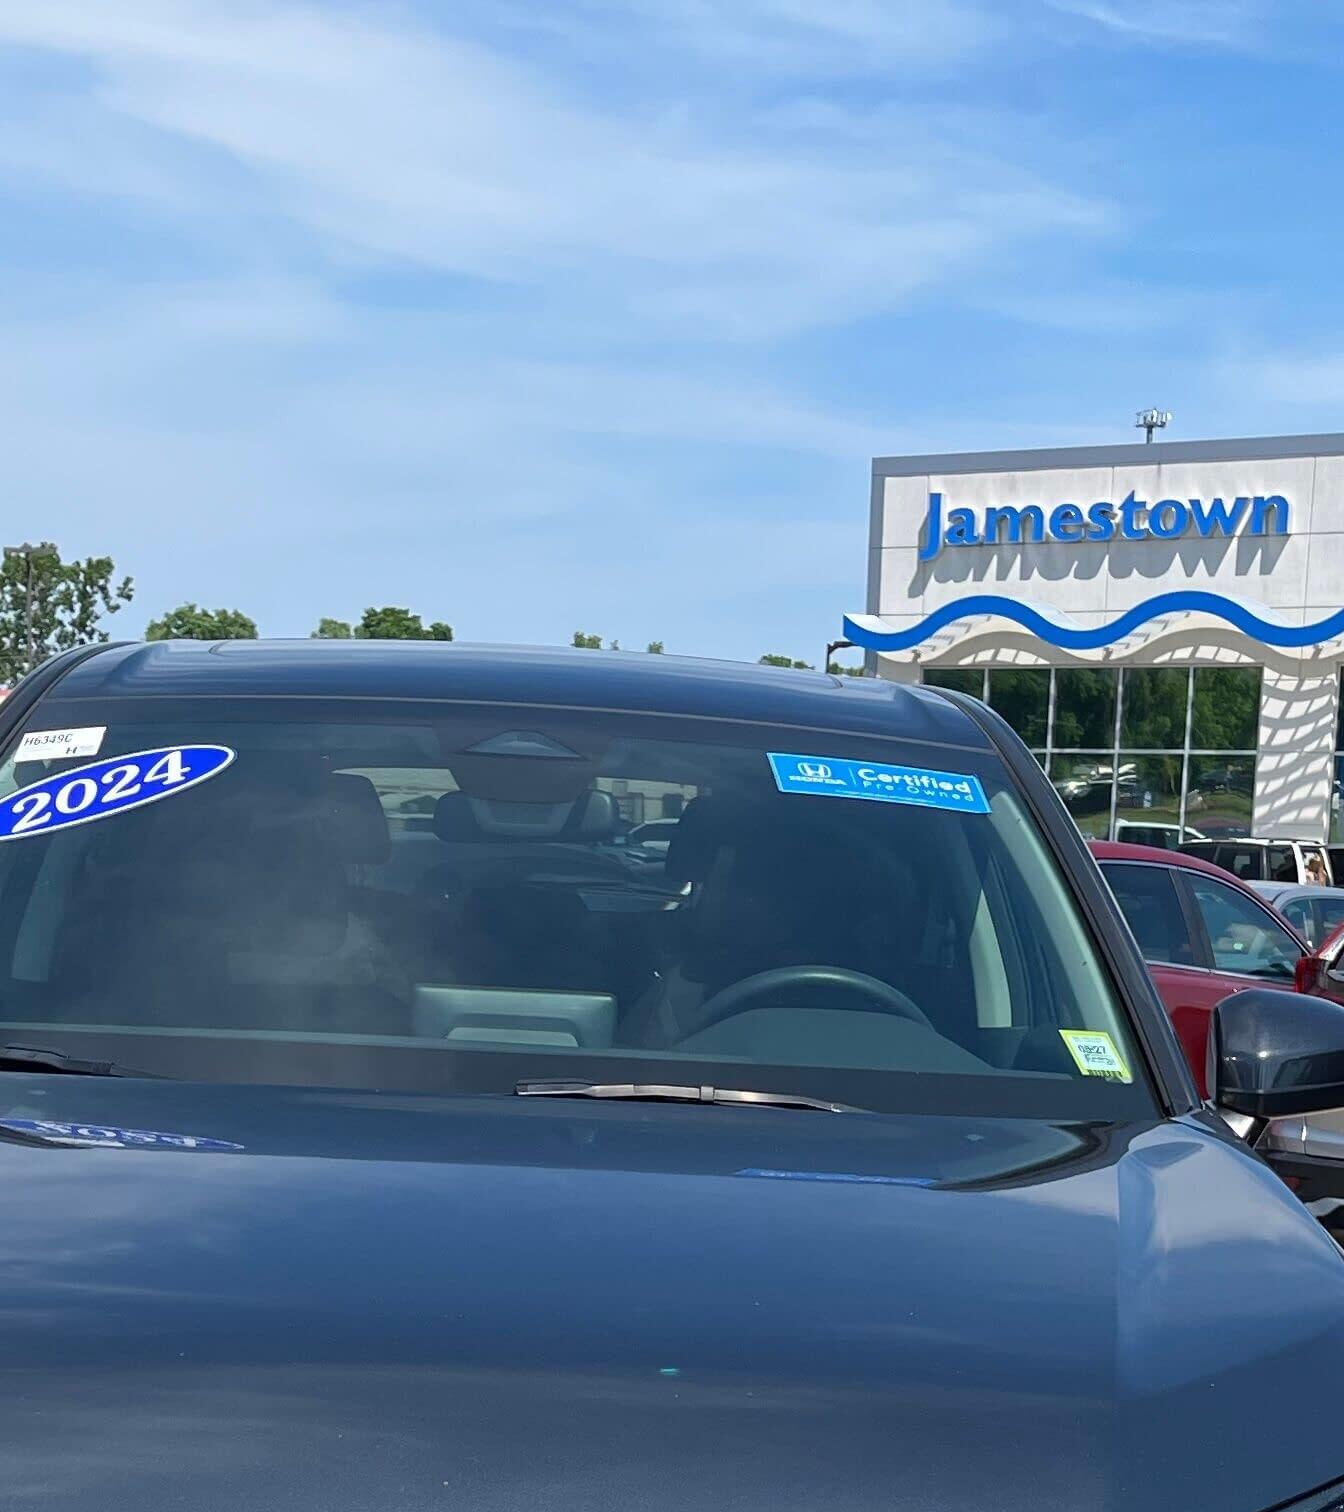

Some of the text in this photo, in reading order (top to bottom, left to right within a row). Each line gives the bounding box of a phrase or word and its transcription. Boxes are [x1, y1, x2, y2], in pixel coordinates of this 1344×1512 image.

[918, 489, 1289, 562] Jamestown
[10, 750, 191, 834] 2024
[788, 775, 847, 786] HONDA
[858, 768, 972, 794] Certified
